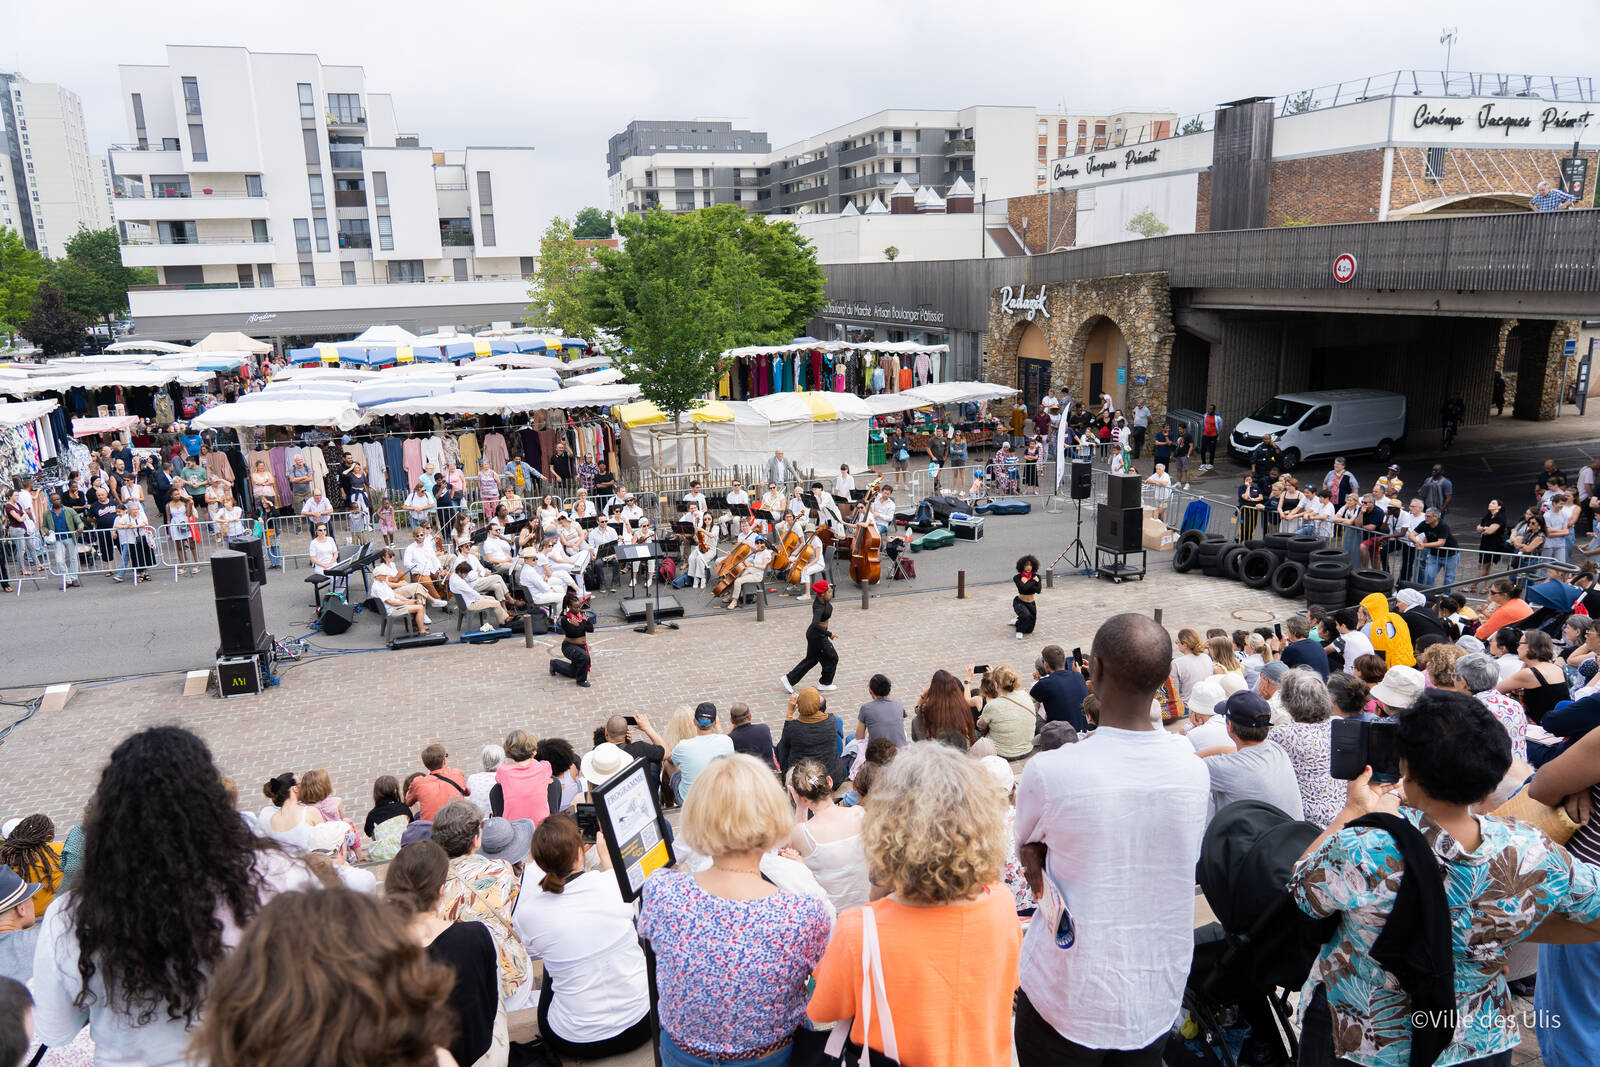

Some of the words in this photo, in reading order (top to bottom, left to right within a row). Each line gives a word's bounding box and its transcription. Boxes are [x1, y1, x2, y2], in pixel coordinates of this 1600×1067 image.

[1413, 103, 1465, 131] Cinéma
[1477, 102, 1532, 137] Jacques
[1086, 155, 1117, 178] Jacques
[606, 774, 644, 807] PROGRAMME
